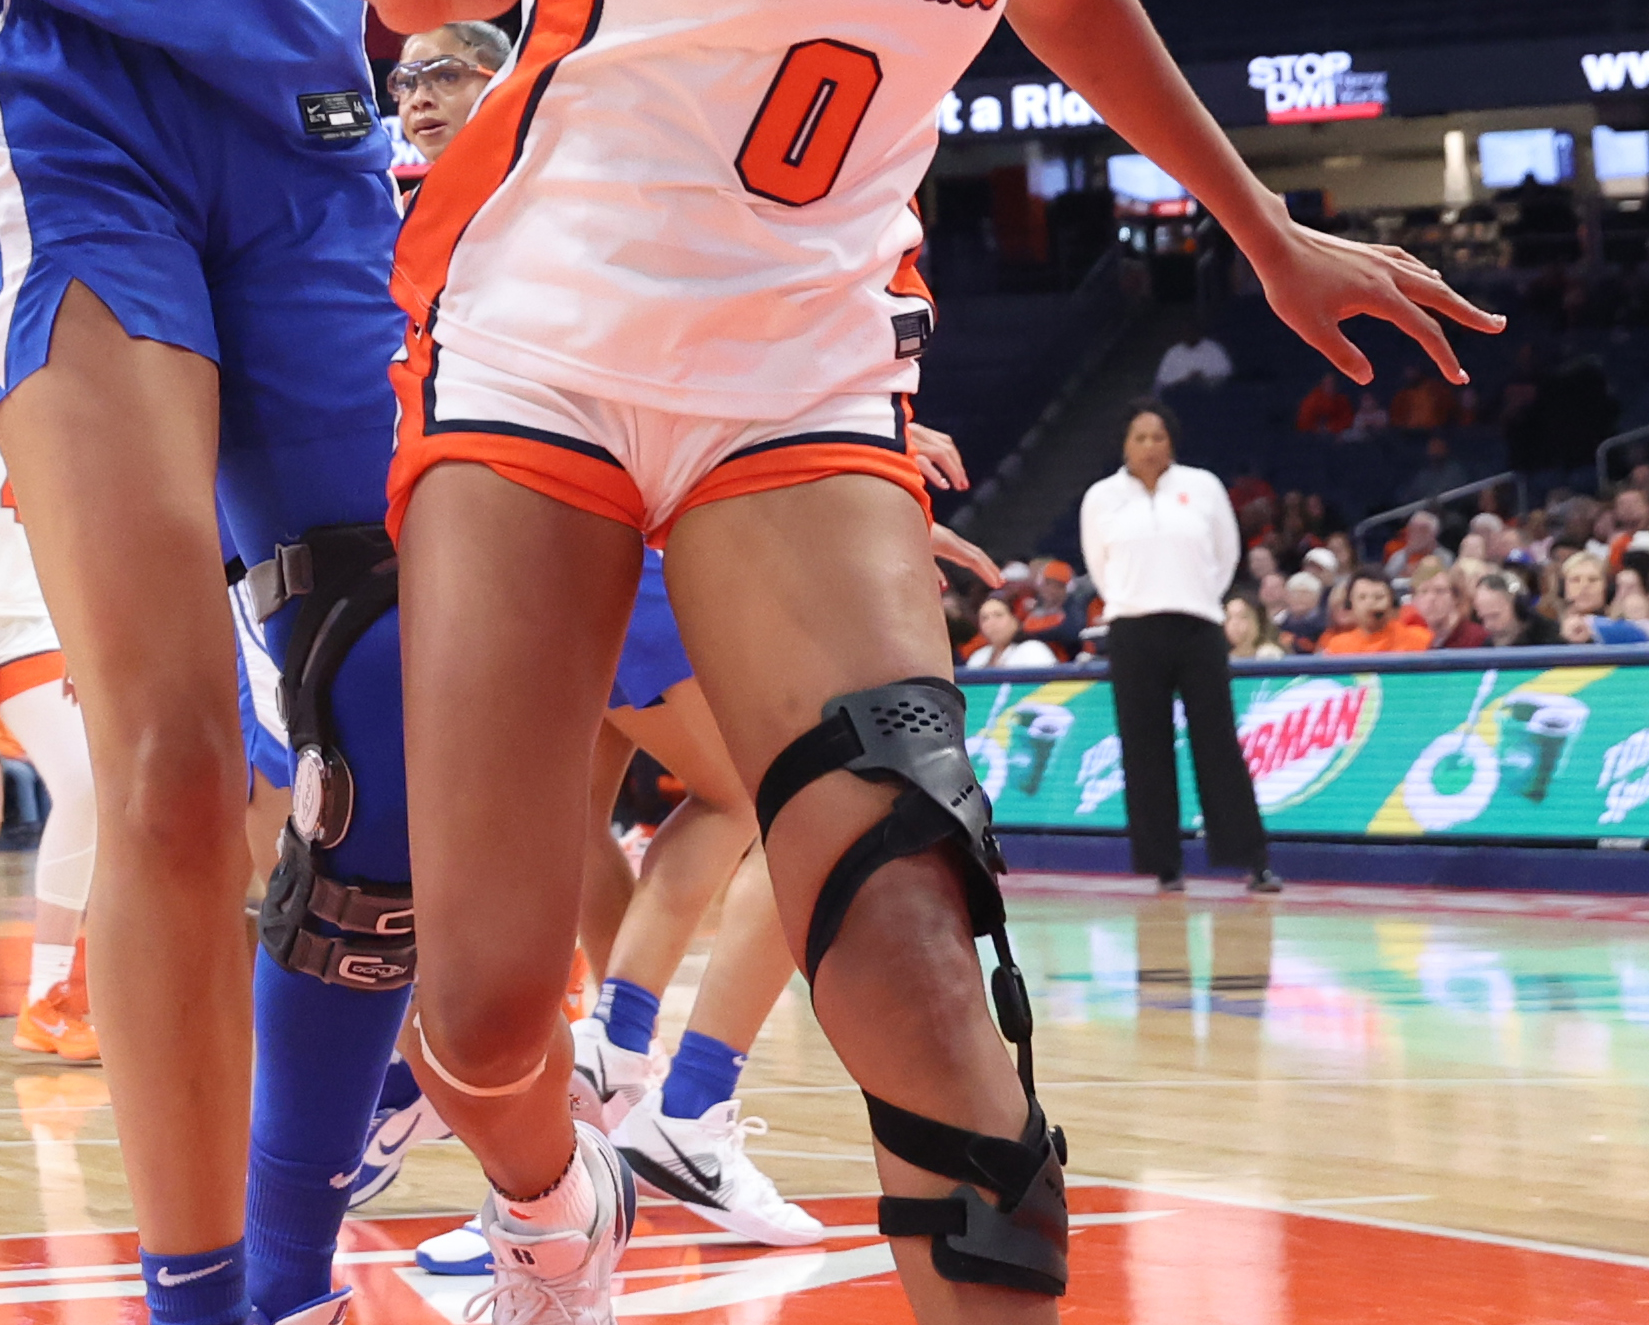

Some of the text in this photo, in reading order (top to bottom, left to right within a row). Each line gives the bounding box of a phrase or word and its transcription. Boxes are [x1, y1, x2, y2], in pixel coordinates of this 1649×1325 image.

[1248, 51, 1352, 89] STOP
[970, 95, 1002, 132] a
[1265, 78, 1337, 113] DWI
[734, 37, 883, 207] 0
